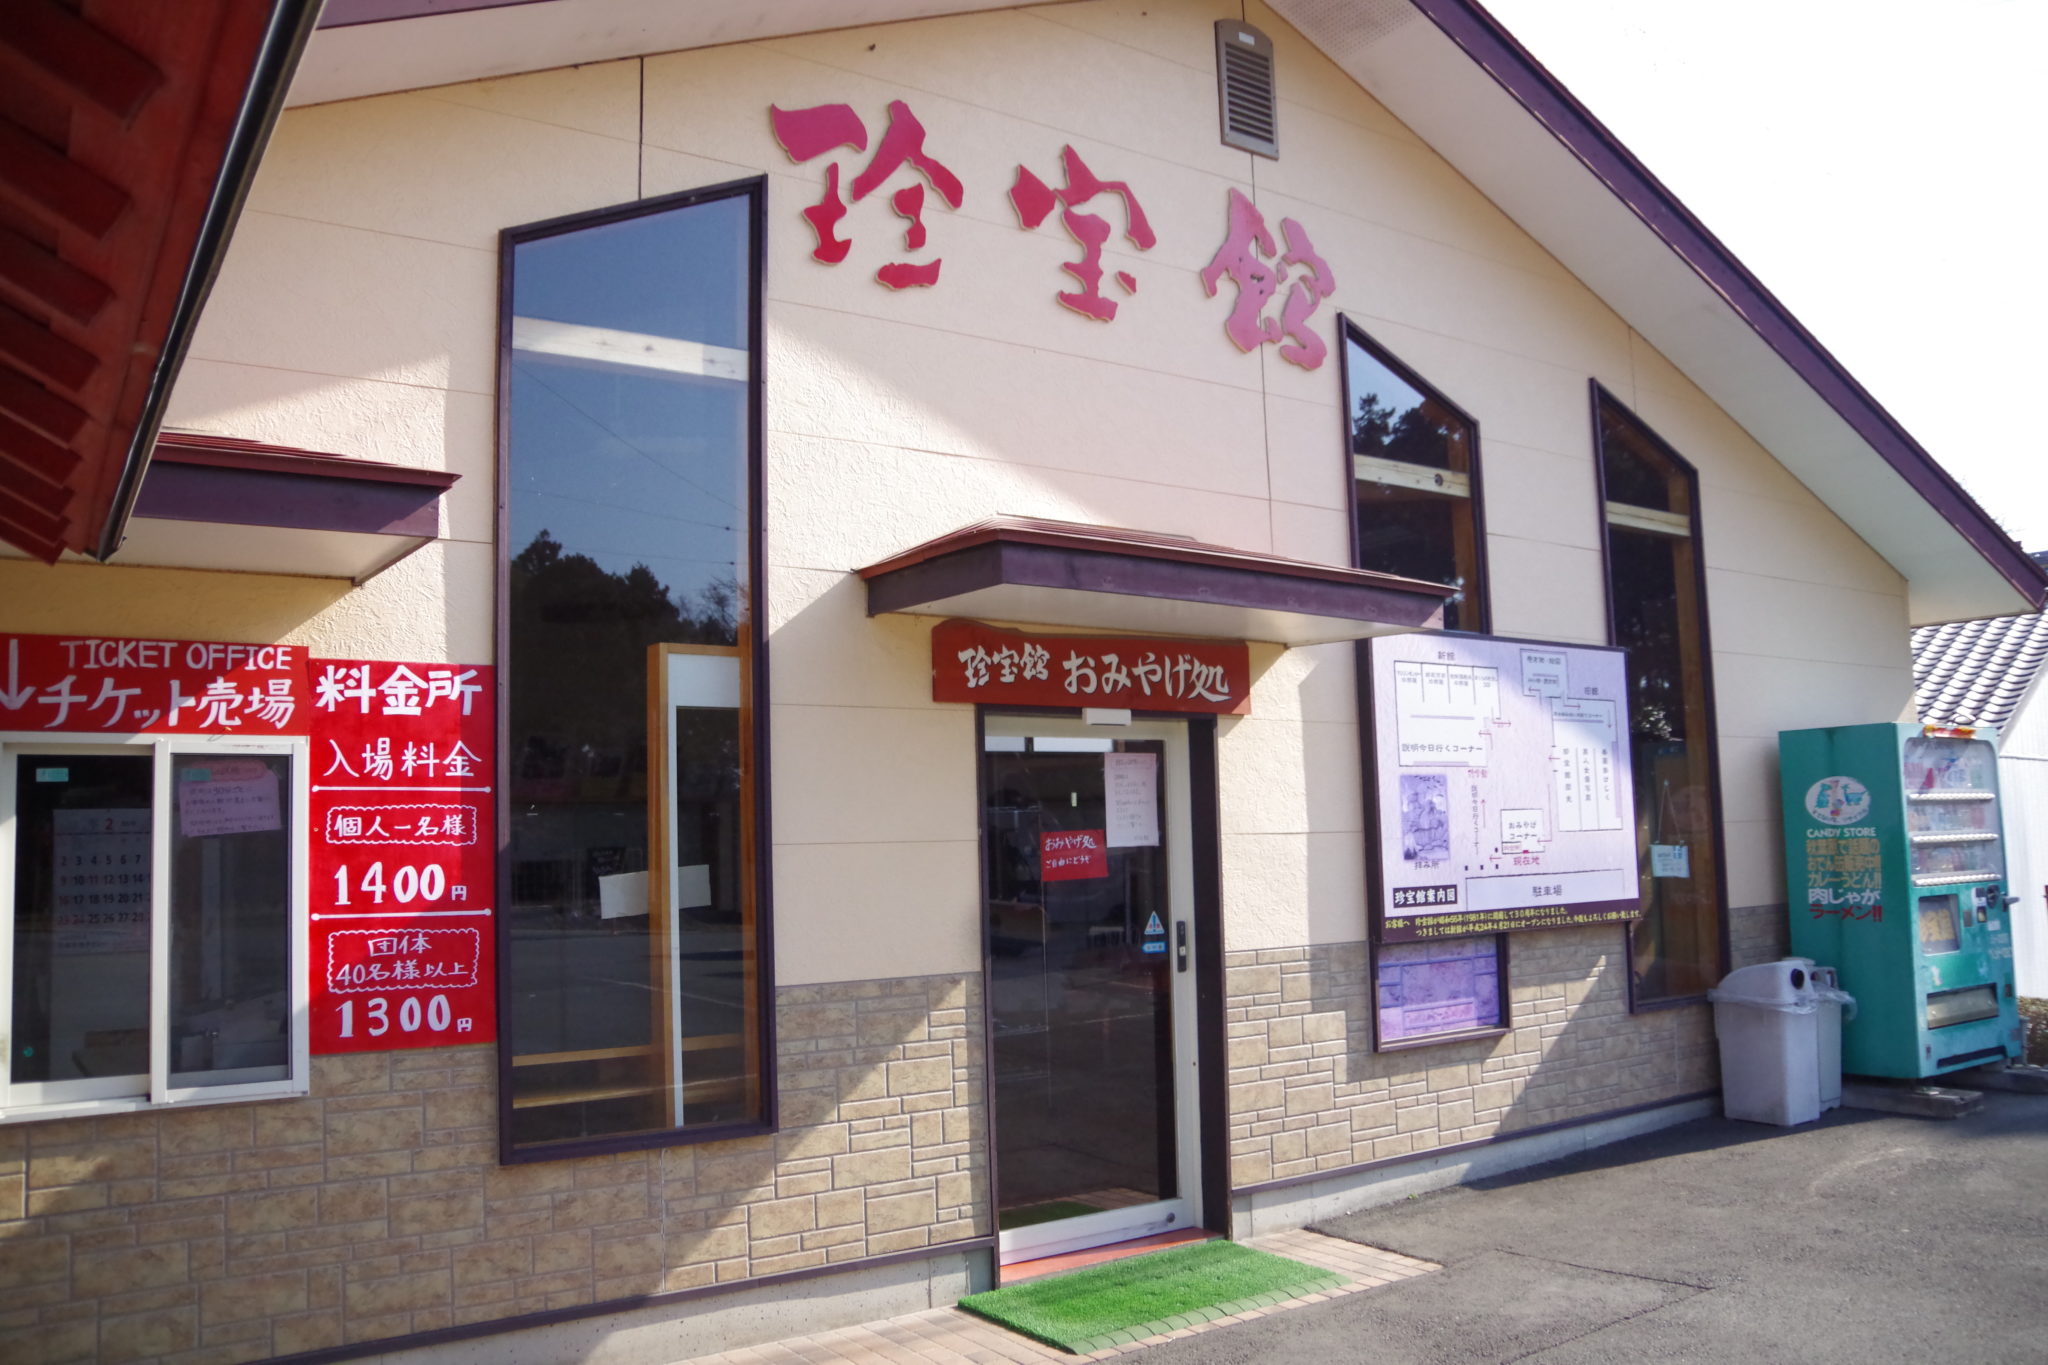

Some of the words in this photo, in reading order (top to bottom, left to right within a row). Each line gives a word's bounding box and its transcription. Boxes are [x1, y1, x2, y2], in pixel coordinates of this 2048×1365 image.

[771, 100, 1336, 370] 珍宝館
[60, 640, 179, 669] TICKET
[187, 643, 292, 671] OFFICE
[958, 642, 1050, 688] 珍宝館
[1062, 650, 1233, 702] おみやげ処
[315, 664, 483, 716] 料金所
[38, 676, 296, 729] チケット売場
[323, 738, 483, 780] 入場料金
[105, 818, 113, 830] 2
[334, 813, 466, 838] 個人一名様
[1806, 828, 1841, 838] CANDY
[1843, 827, 1877, 837] STORE
[1045, 834, 1097, 852] おみやげ処
[75, 856, 82, 866] 3
[90, 855, 97, 865] 4
[105, 855, 112, 865] 5
[120, 855, 127, 865] 6
[135, 854, 142, 865] 7
[1045, 855, 1090, 869] ご自由にどうぞ
[1513, 855, 1540, 866] 現在地
[73, 875, 85, 886] 10
[89, 875, 99, 885] 11
[104, 875, 115, 885] 12
[118, 874, 129, 884] 13
[133, 874, 144, 884] 14
[334, 861, 468, 905] 1400円
[73, 895, 84, 905] 17
[89, 895, 99, 904] 18
[104, 895, 114, 904] 19
[118, 894, 129, 904] 20
[132, 894, 143, 904] 21
[1394, 888, 1456, 905] 珍宝館案内図
[1532, 884, 1562, 897] 駐車場
[1808, 888, 1881, 905] 肉じゃが
[88, 914, 100, 924] 25
[103, 913, 114, 923] 26
[118, 912, 129, 923] 27
[367, 933, 432, 957] 団体
[336, 958, 469, 986] 40名様以上
[336, 994, 472, 1039] 1300円
